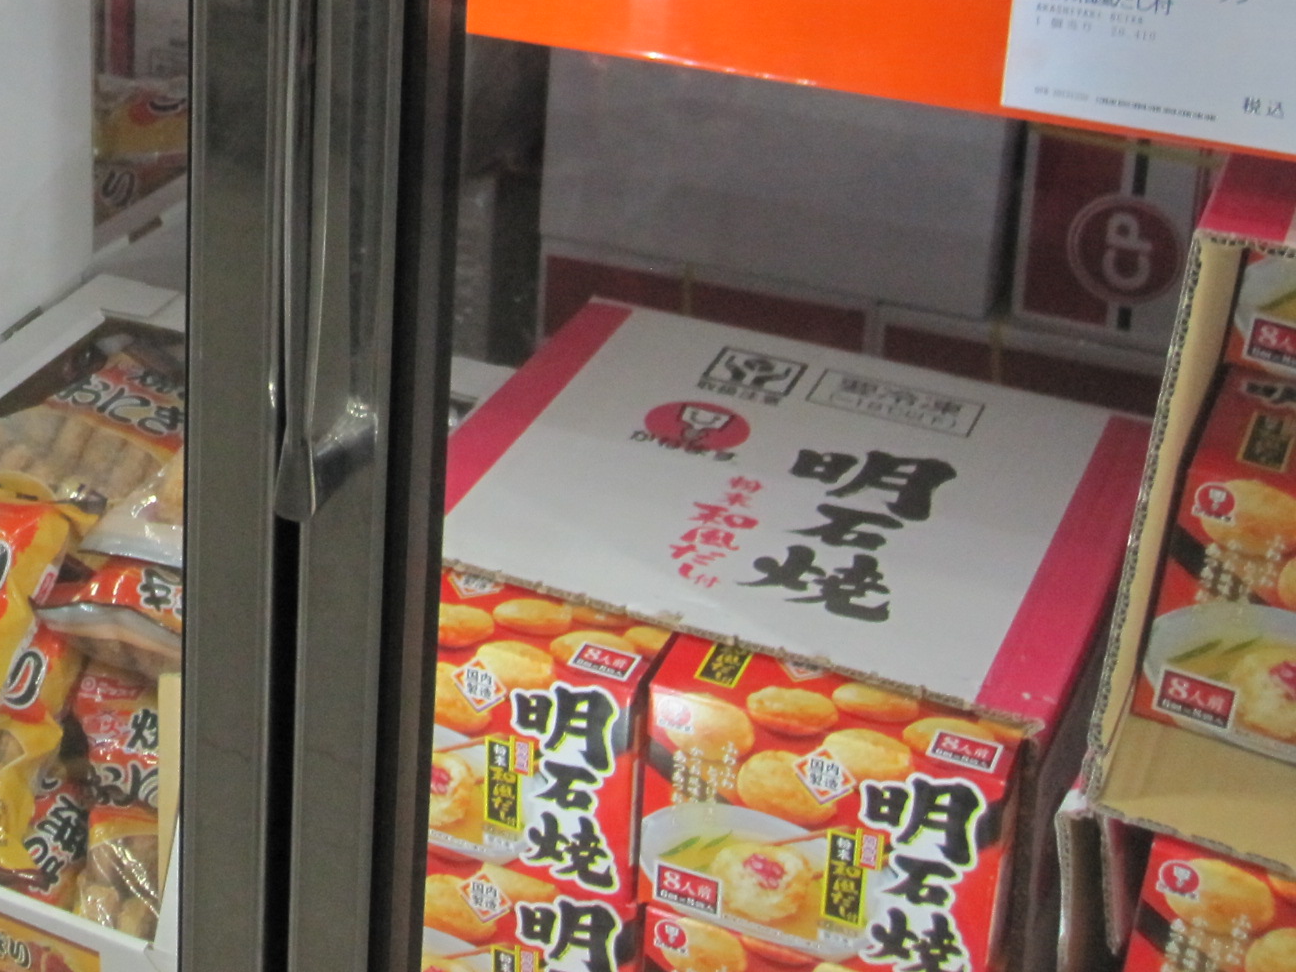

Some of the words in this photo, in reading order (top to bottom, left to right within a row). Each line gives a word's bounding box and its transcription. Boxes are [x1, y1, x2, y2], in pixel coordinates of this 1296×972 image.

[1242, 95, 1286, 119] 税込
[668, 475, 764, 589] 粉末和風だし付
[737, 448, 958, 623] 明石焼
[583, 647, 630, 670] 8人前
[465, 667, 493, 684] 国内
[940, 736, 990, 759] 8人前
[809, 758, 841, 776] 国内
[514, 685, 615, 890] 明石焼
[662, 869, 712, 901] 8人前
[864, 777, 980, 972] 明石焼
[471, 881, 498, 899] 国内
